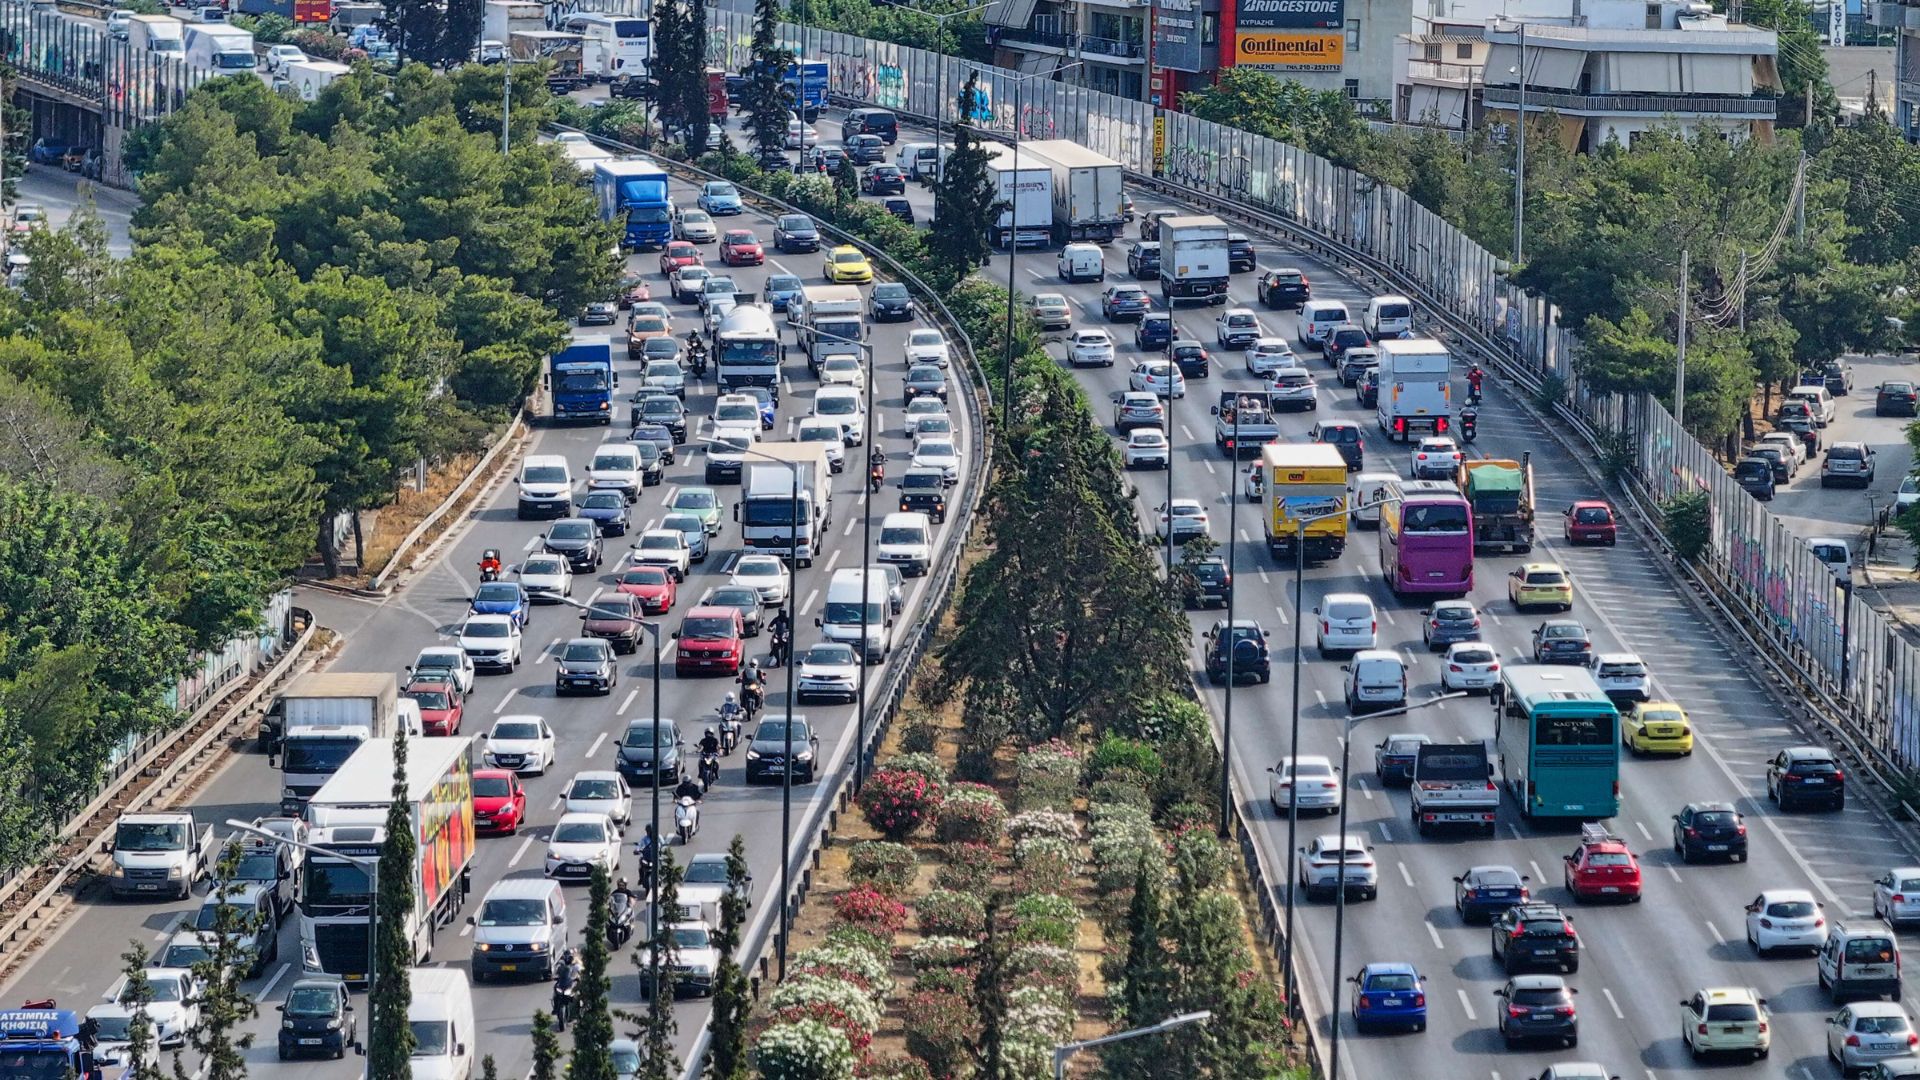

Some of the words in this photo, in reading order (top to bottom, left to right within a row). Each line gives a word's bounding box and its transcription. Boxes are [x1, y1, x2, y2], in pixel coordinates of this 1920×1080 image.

[1243, 0, 1339, 13] BRIDGESTONE
[1241, 37, 1324, 54] Continental
[0, 1012, 59, 1021] ΑΤΣΙΜΠΑΣ
[1, 1022, 47, 1030] ΚΗΦΙΣΙΑ
